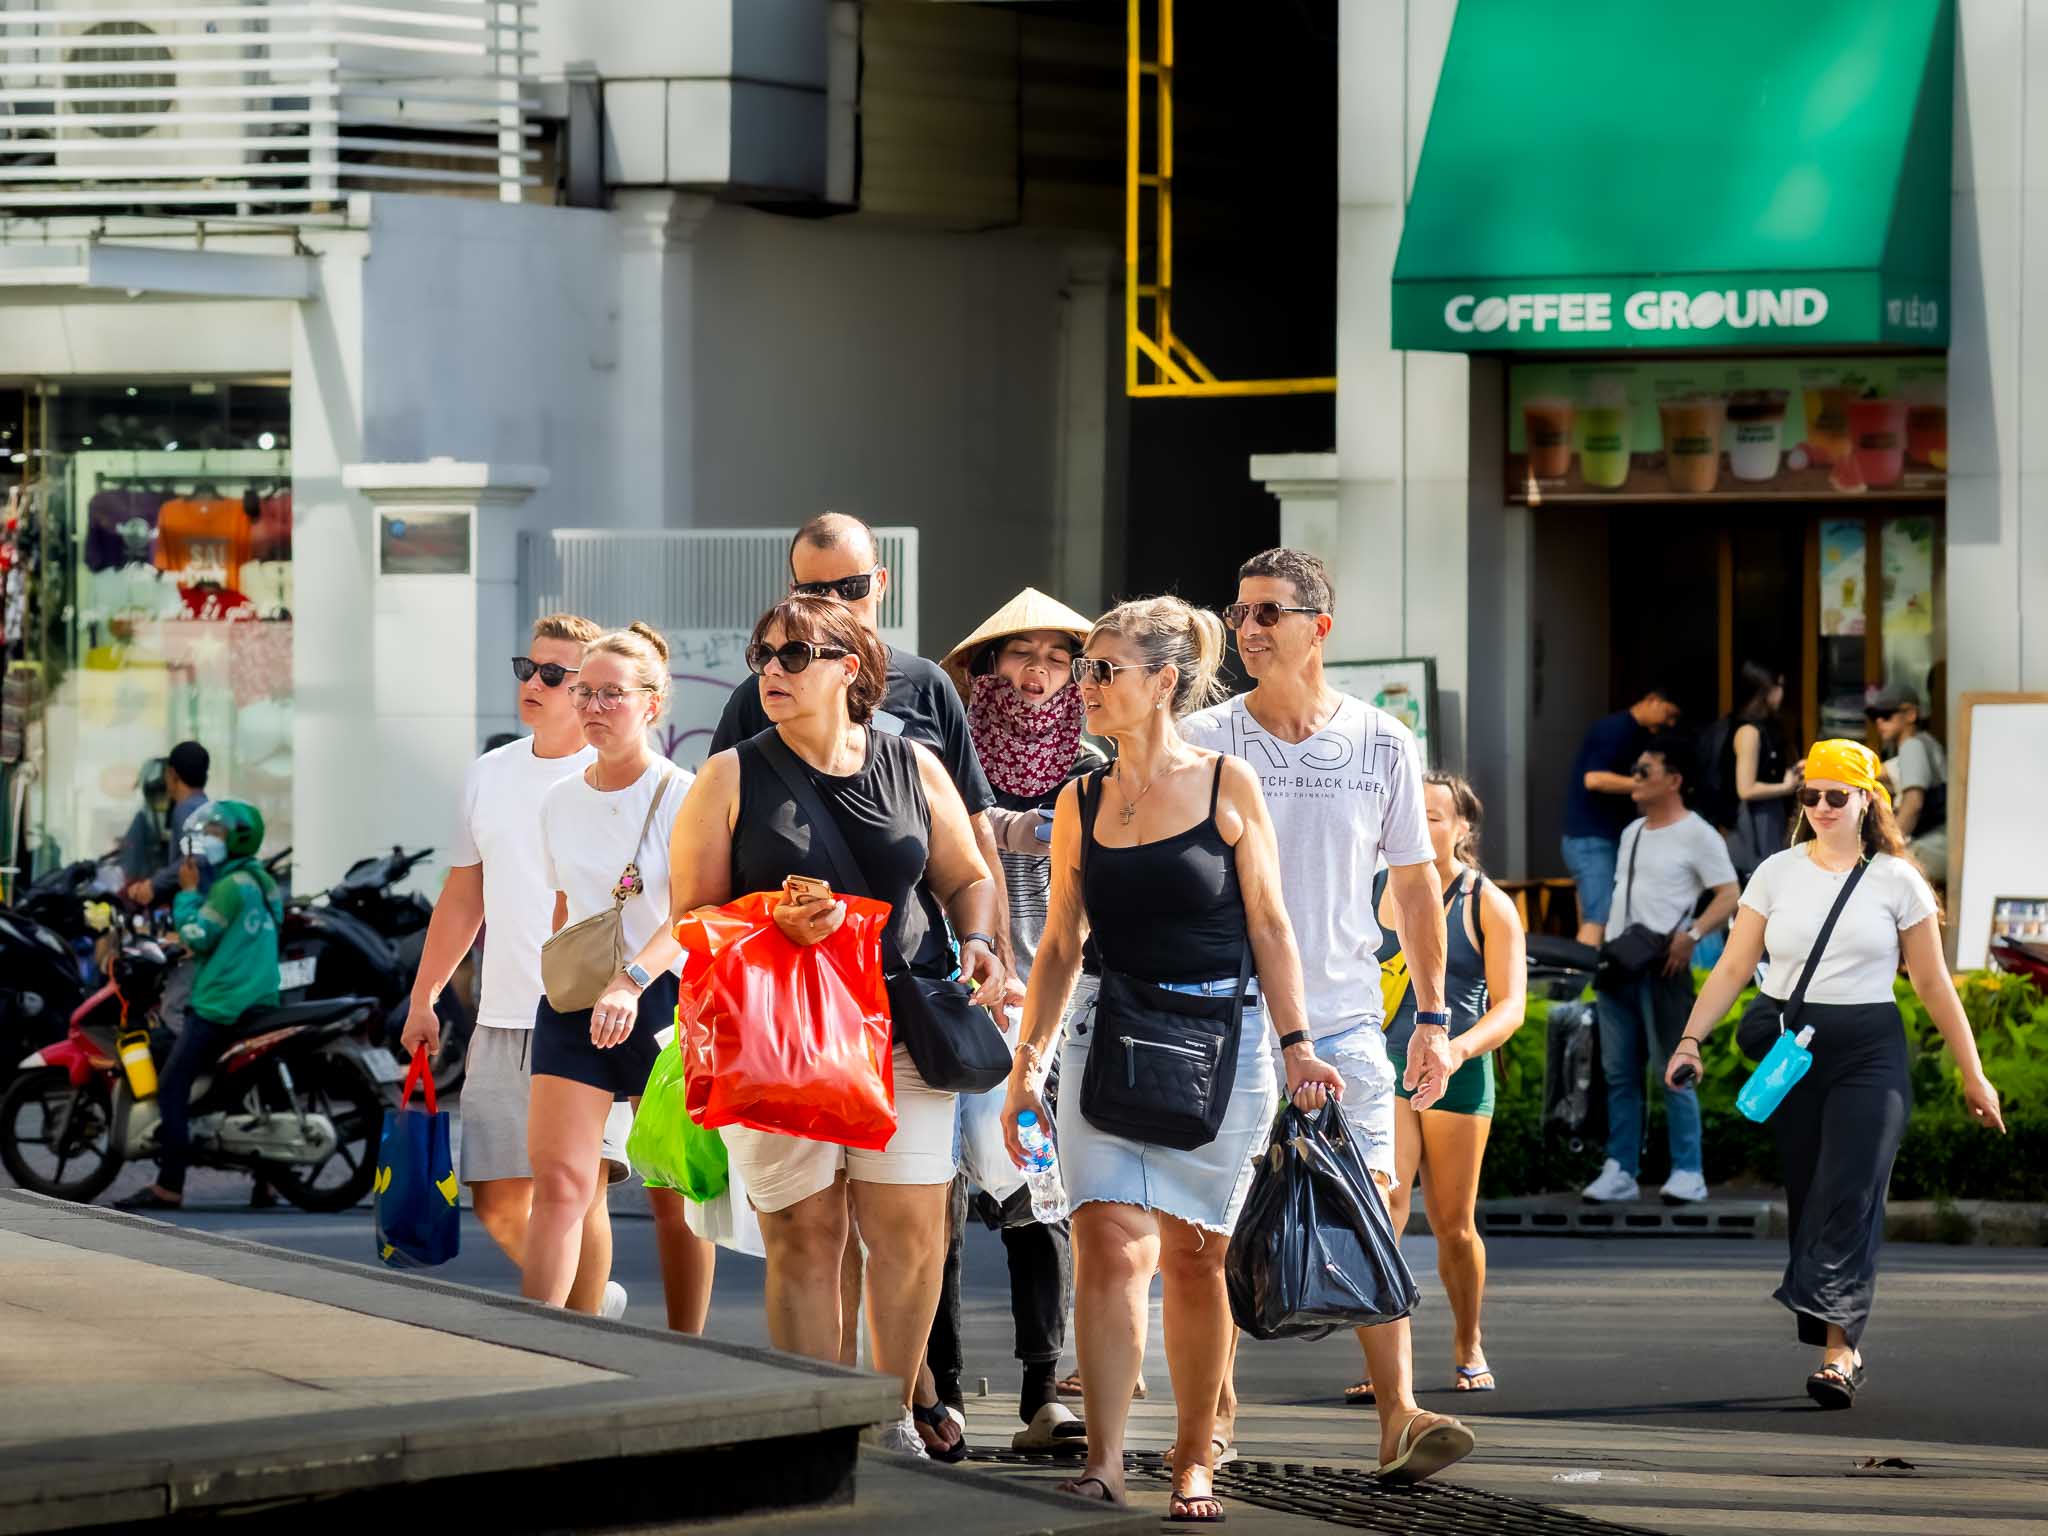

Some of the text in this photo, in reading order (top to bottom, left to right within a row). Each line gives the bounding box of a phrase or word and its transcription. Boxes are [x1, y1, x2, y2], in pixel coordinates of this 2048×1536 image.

[1443, 288, 1829, 333] COFFEE GROUND
[1348, 779, 1385, 795] LABEL
